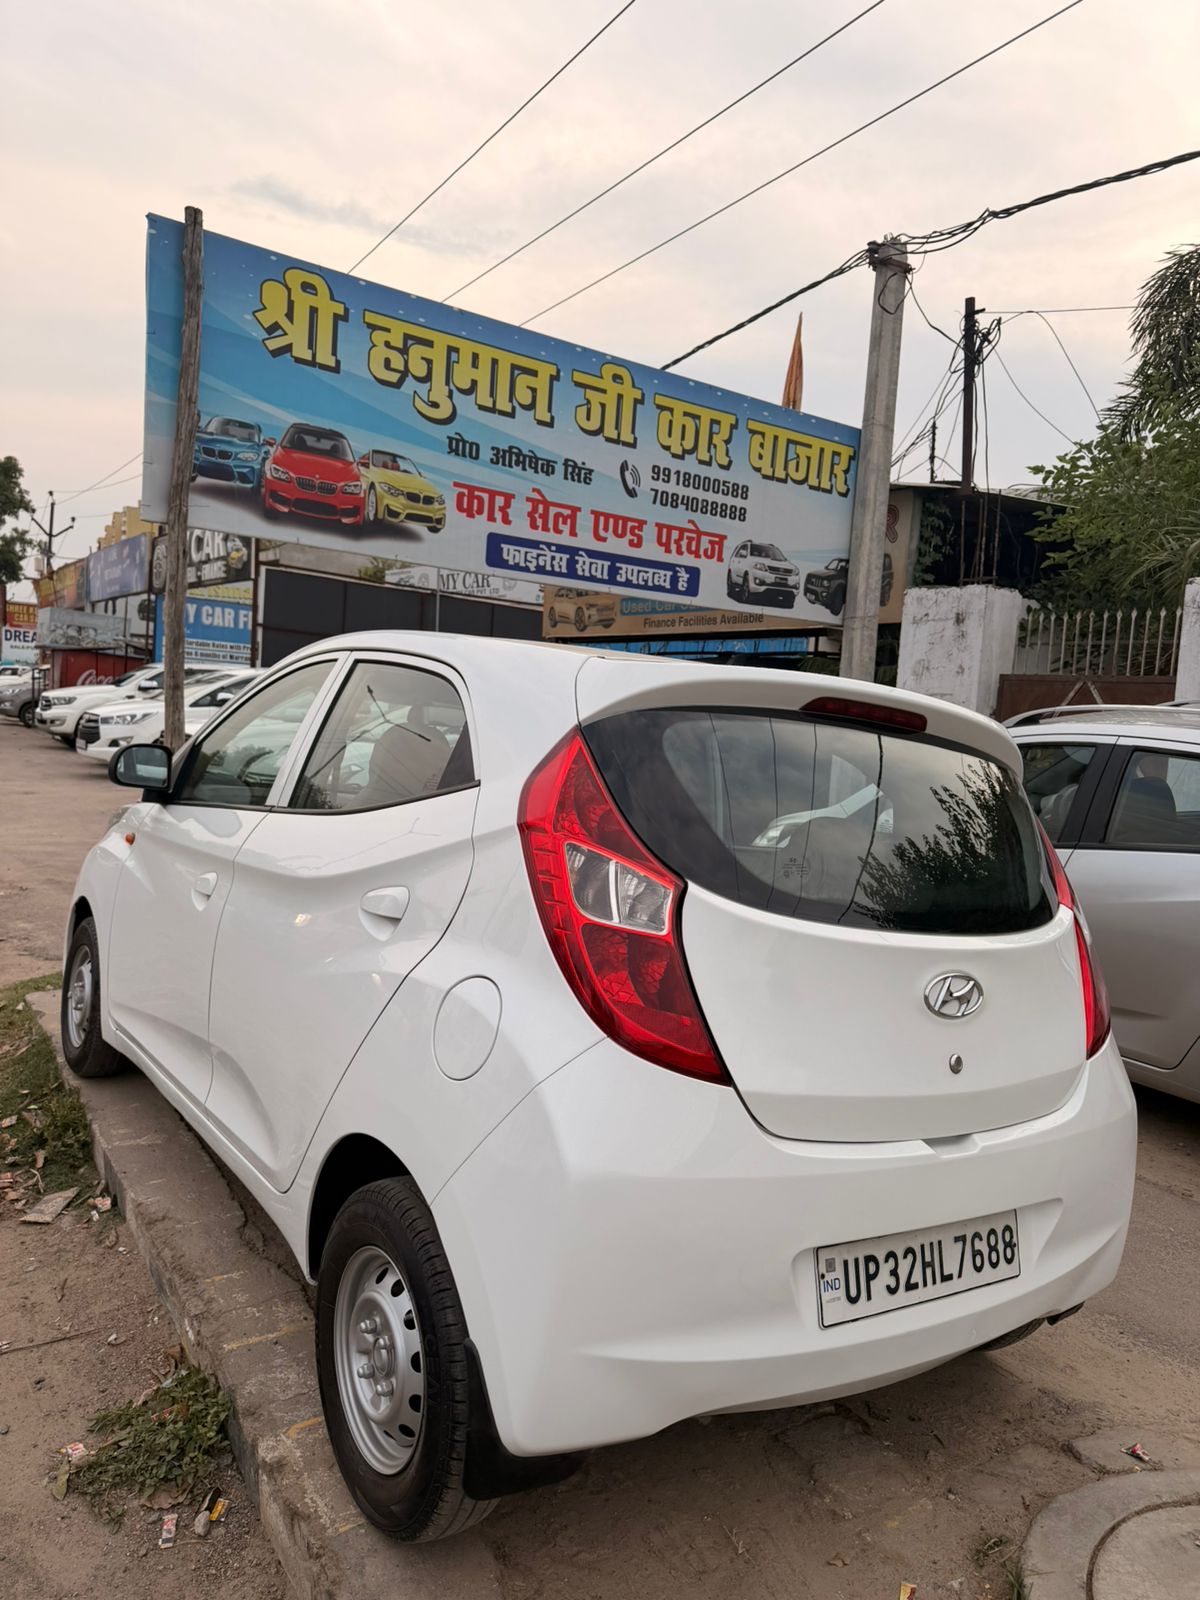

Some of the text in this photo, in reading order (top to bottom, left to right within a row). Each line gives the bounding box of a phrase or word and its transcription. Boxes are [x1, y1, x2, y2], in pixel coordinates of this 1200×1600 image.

[252, 267, 855, 497] श्री हनुमान जी कार बाजार
[563, 458, 594, 485] सिंह
[650, 464, 749, 500] 9918000588
[650, 488, 747, 522] 7084088888
[453, 481, 728, 563] कार सेल एण्ड परचेज
[439, 571, 491, 590] MY CAR
[501, 544, 690, 592] फाइनेंस सेवा उपलब्ध है
[201, 605, 235, 628] CAR
[622, 600, 651, 613] Used
[643, 613, 764, 629] Finance Facilities Available
[843, 1223, 1017, 1305] UP32HL7688
[822, 1277, 841, 1293] IND
